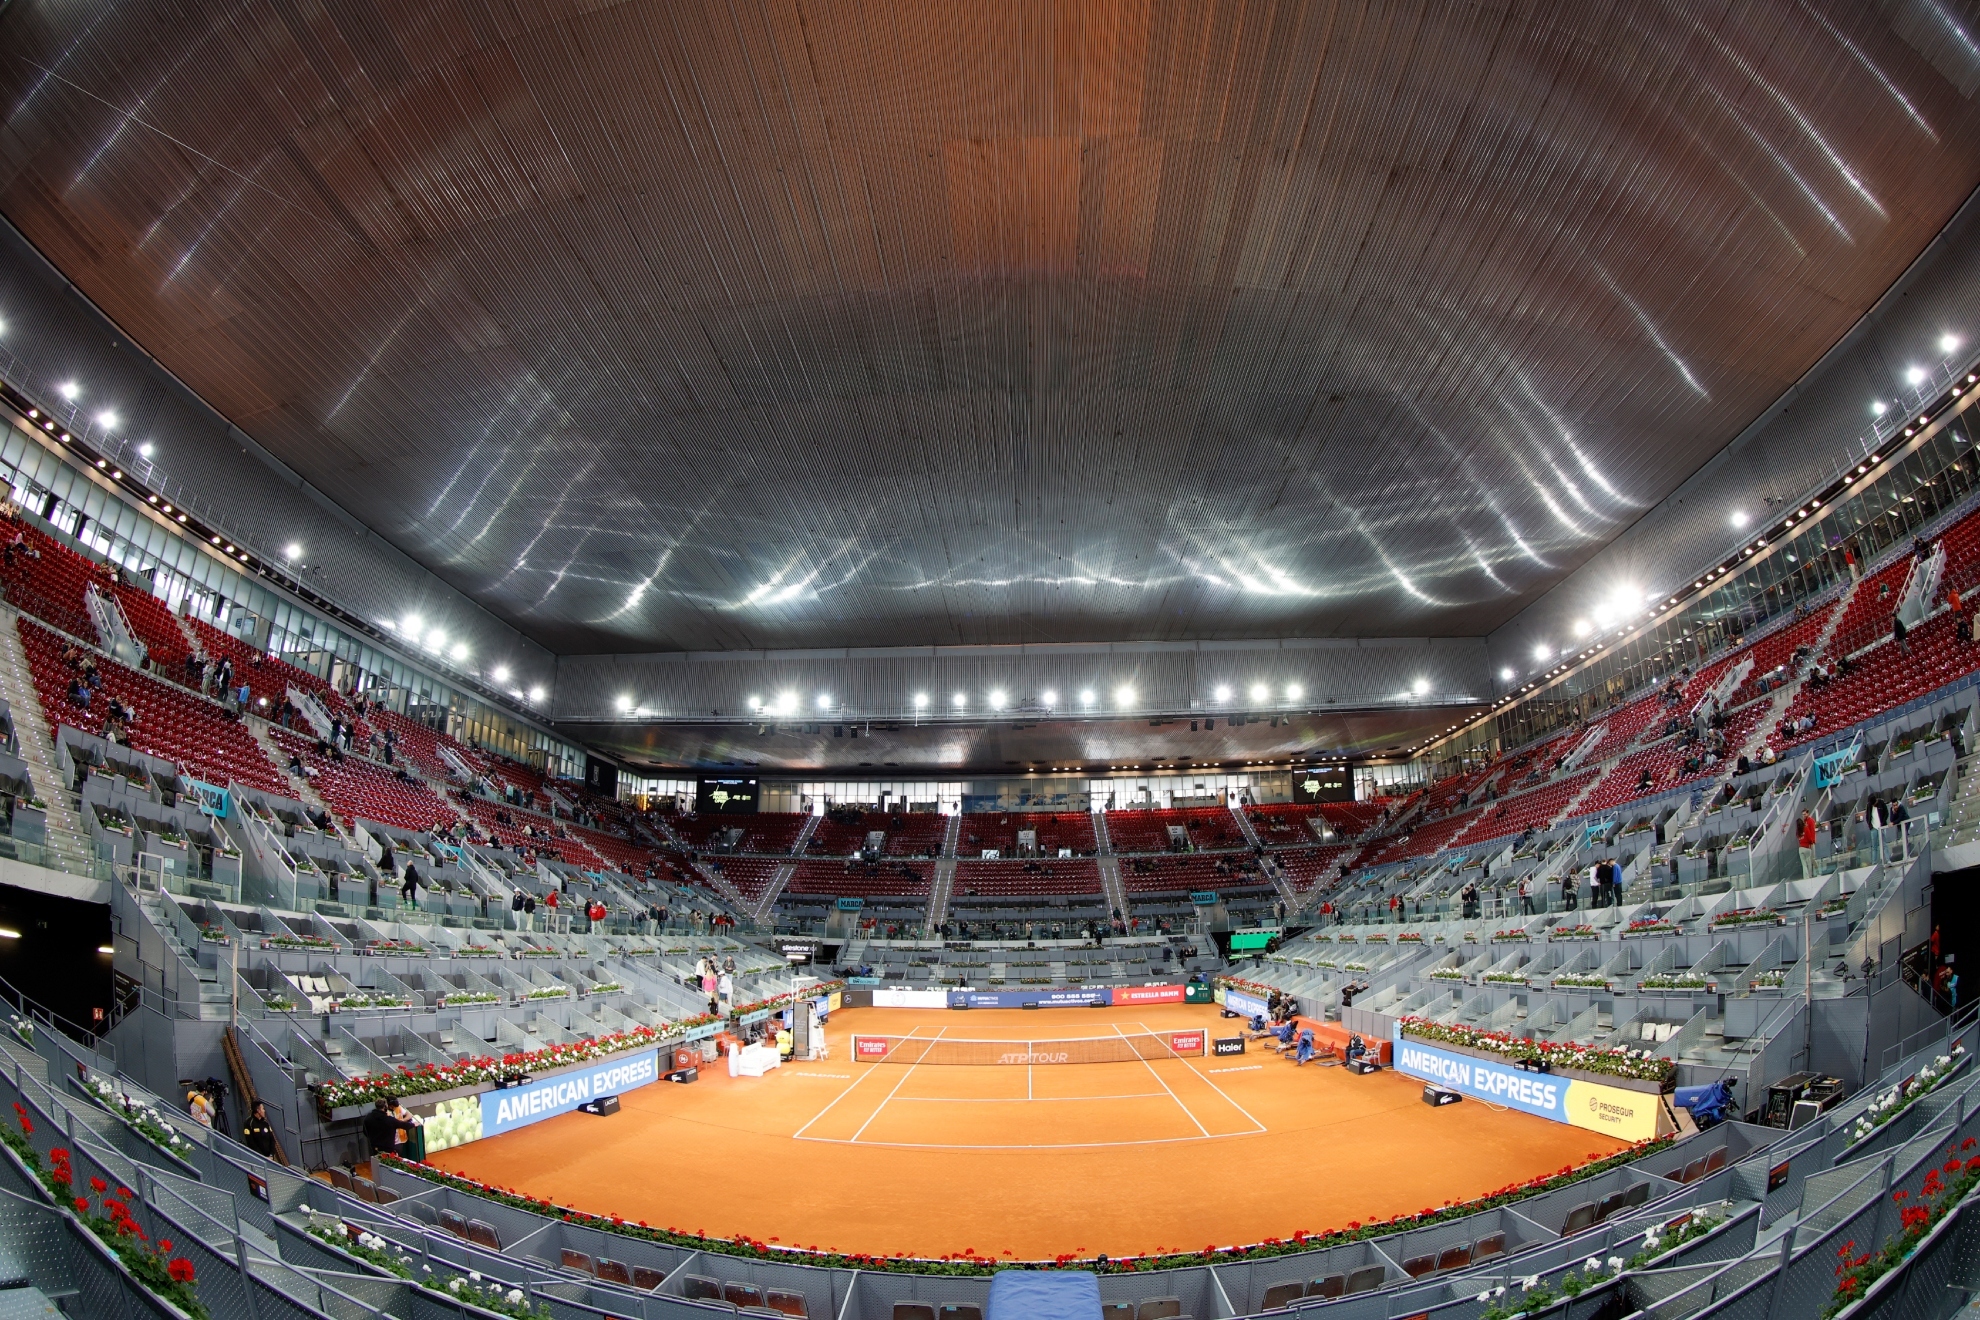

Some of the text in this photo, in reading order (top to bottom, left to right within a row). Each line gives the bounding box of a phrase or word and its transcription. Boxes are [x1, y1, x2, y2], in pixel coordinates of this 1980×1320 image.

[1173, 1036, 1200, 1044] Emirates
[1218, 1043, 1242, 1052] Haier
[997, 1052, 1069, 1064] ATP TOUR
[1401, 1048, 1557, 1110] AMERICAN EXPRESS
[496, 1058, 652, 1125] AMERICAN EXPRESS
[1599, 1102, 1634, 1118] PROSEGUR
[1598, 1112, 1622, 1124] SECURITY
